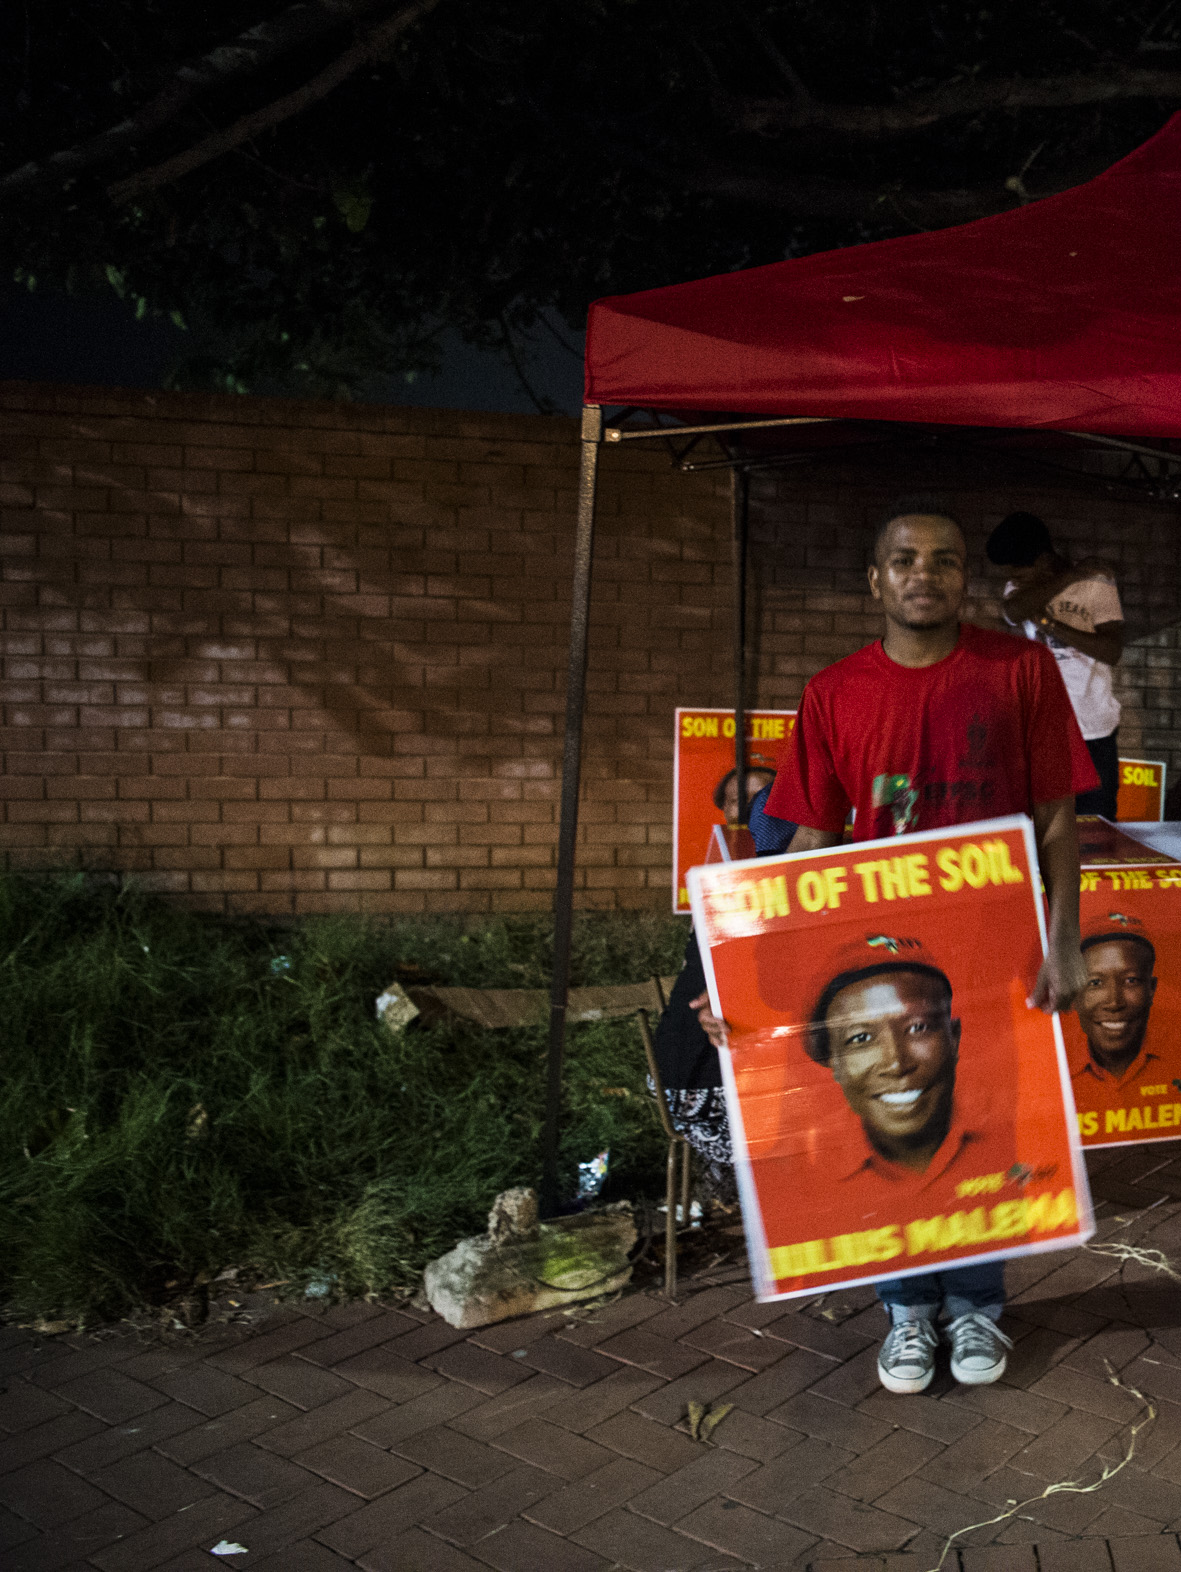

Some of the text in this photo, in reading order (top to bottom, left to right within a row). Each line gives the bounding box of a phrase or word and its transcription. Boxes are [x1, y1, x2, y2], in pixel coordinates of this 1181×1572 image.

[681, 717, 719, 738] SON
[751, 718, 785, 739] THE
[1122, 766, 1158, 788] SOIL
[796, 866, 848, 913] OF
[853, 853, 933, 903] THE
[936, 838, 1025, 893] SOIL
[1105, 870, 1153, 891] THE
[1140, 1084, 1168, 1097] VOTE
